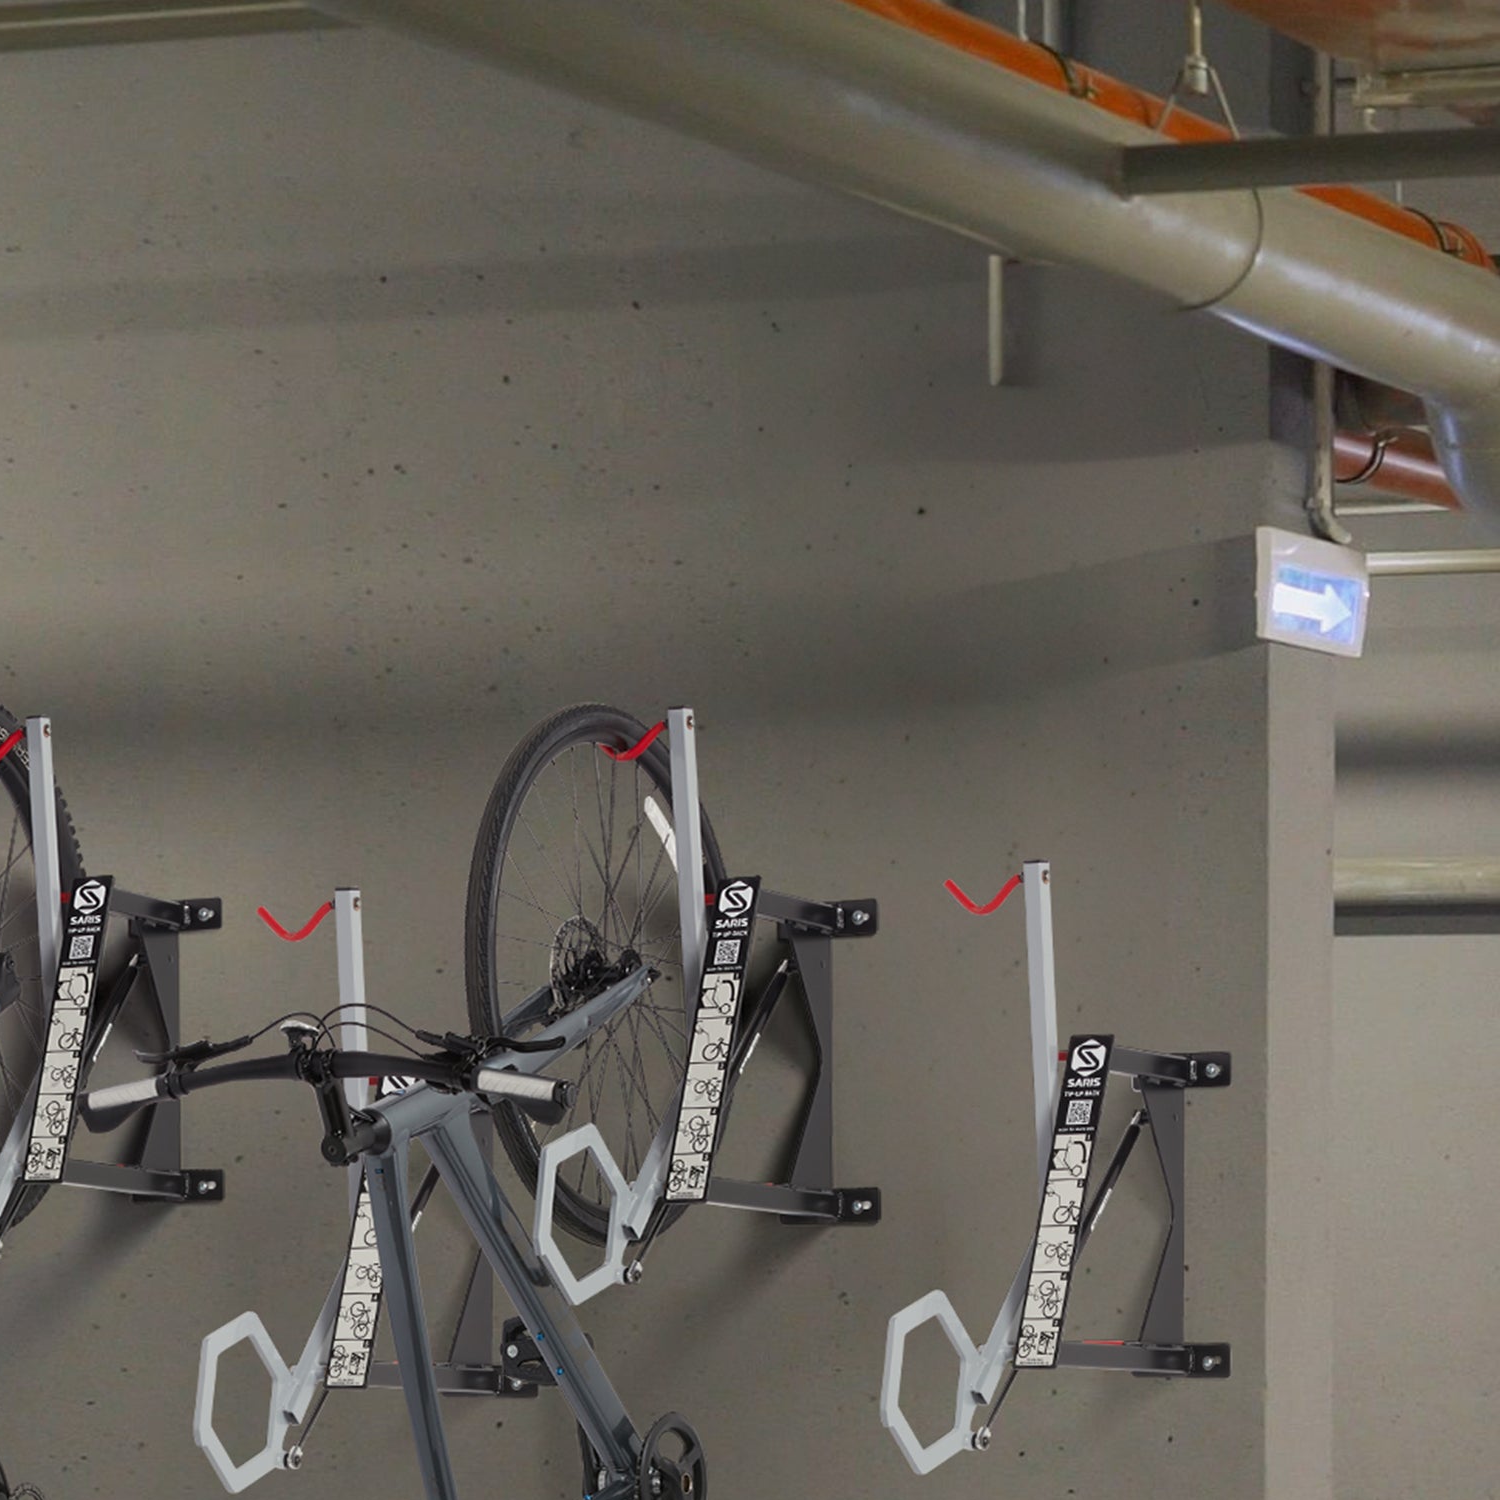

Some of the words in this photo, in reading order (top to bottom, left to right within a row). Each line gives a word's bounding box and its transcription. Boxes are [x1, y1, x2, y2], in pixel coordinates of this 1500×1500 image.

[70, 915, 102, 926] SARIS
[715, 918, 748, 929] SARIS
[1067, 1077, 1102, 1088] SARIS
